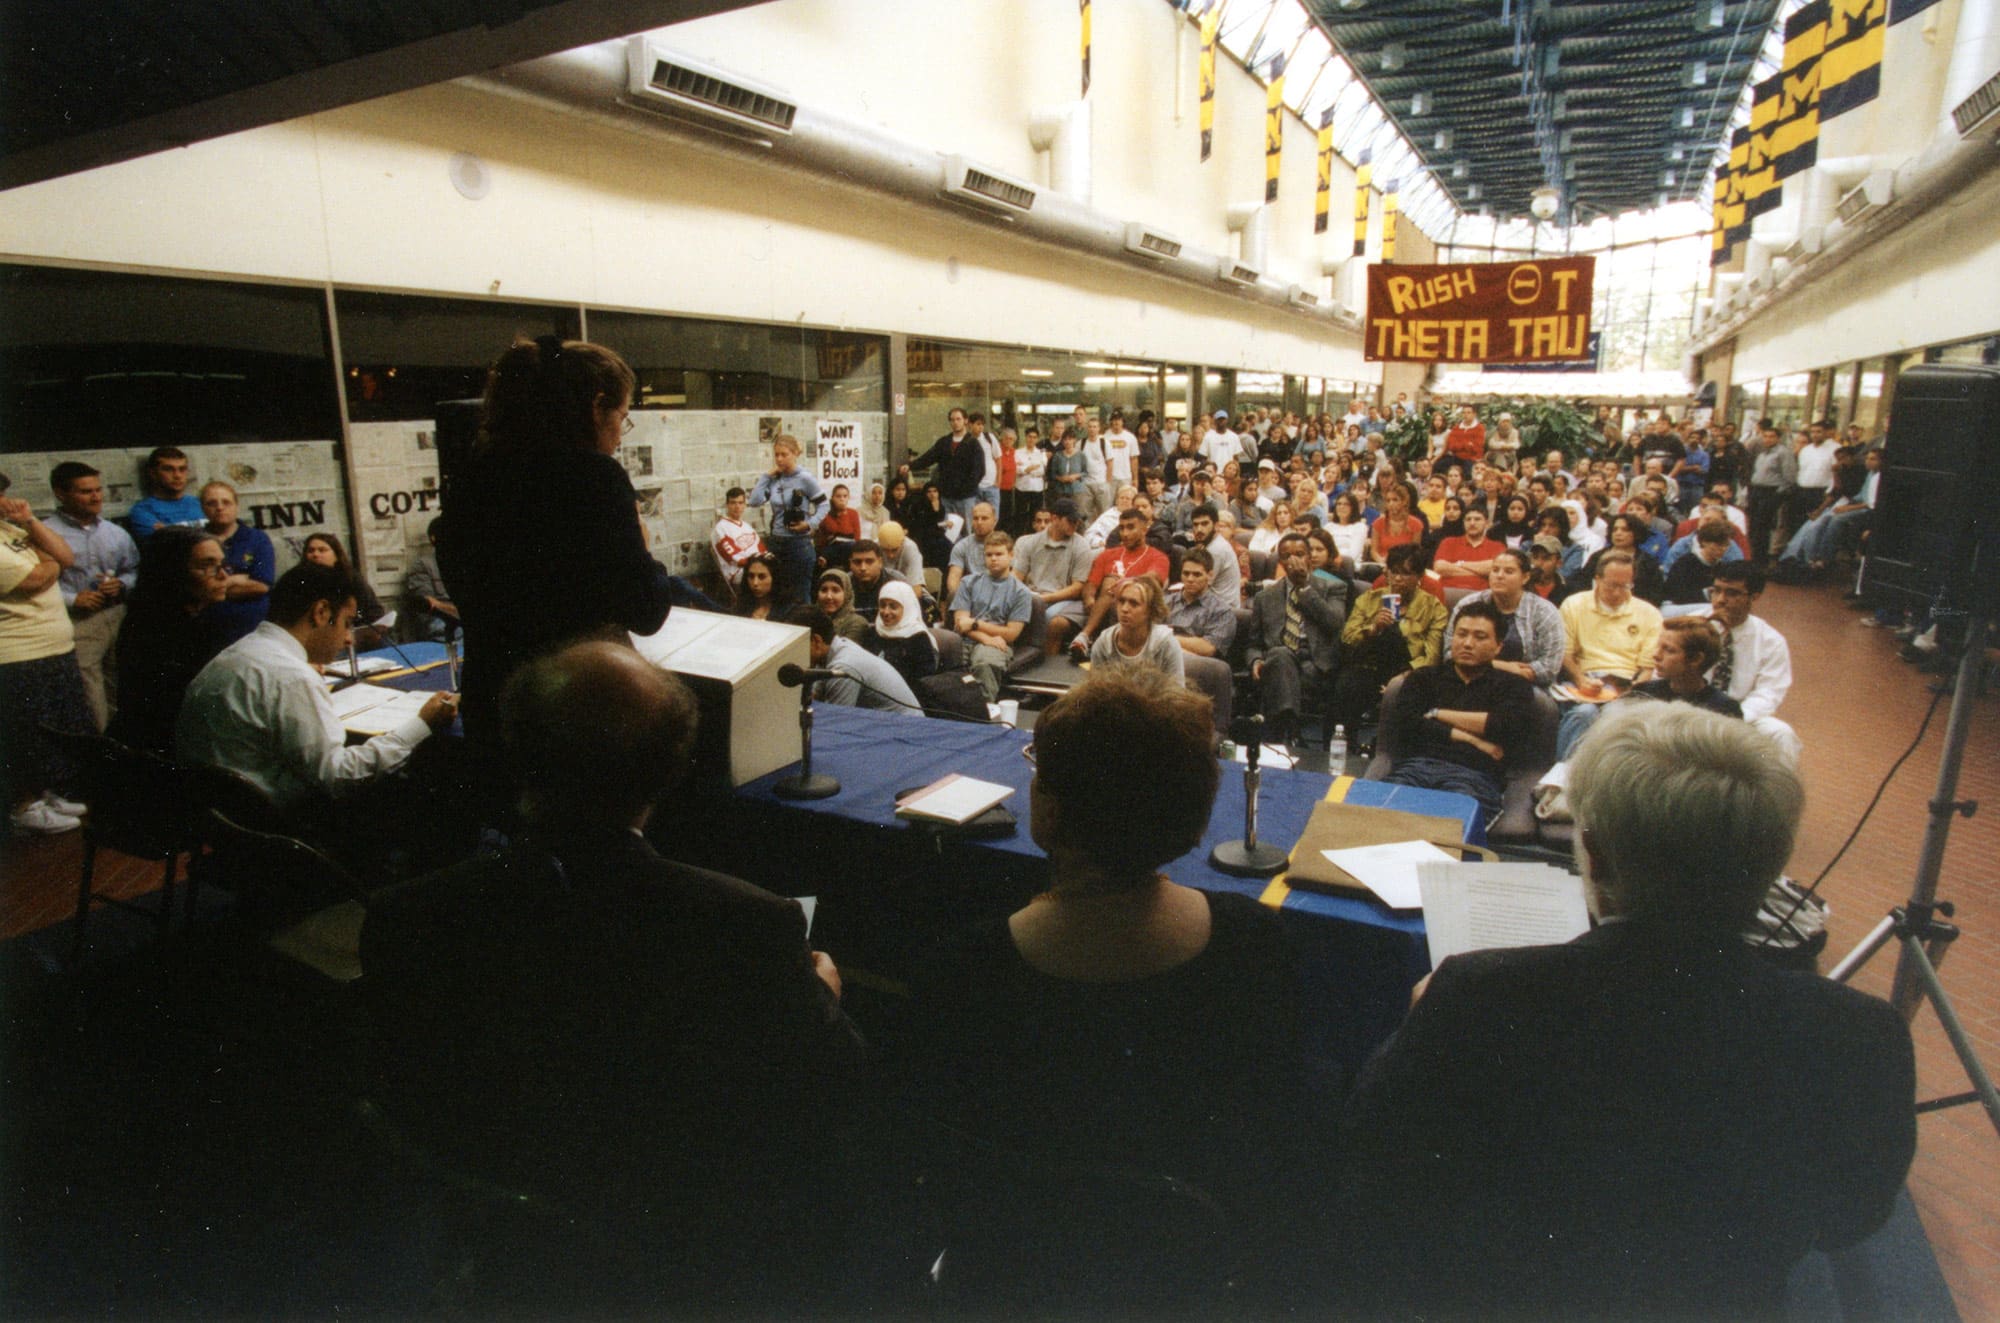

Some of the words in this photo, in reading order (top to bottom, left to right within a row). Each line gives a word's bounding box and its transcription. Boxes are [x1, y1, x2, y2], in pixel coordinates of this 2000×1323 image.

[1373, 317, 1489, 360] THETA
[1508, 314, 1586, 359] TAU
[819, 425, 855, 439] WANT
[831, 441, 860, 458] Give
[823, 459, 859, 479] Blood
